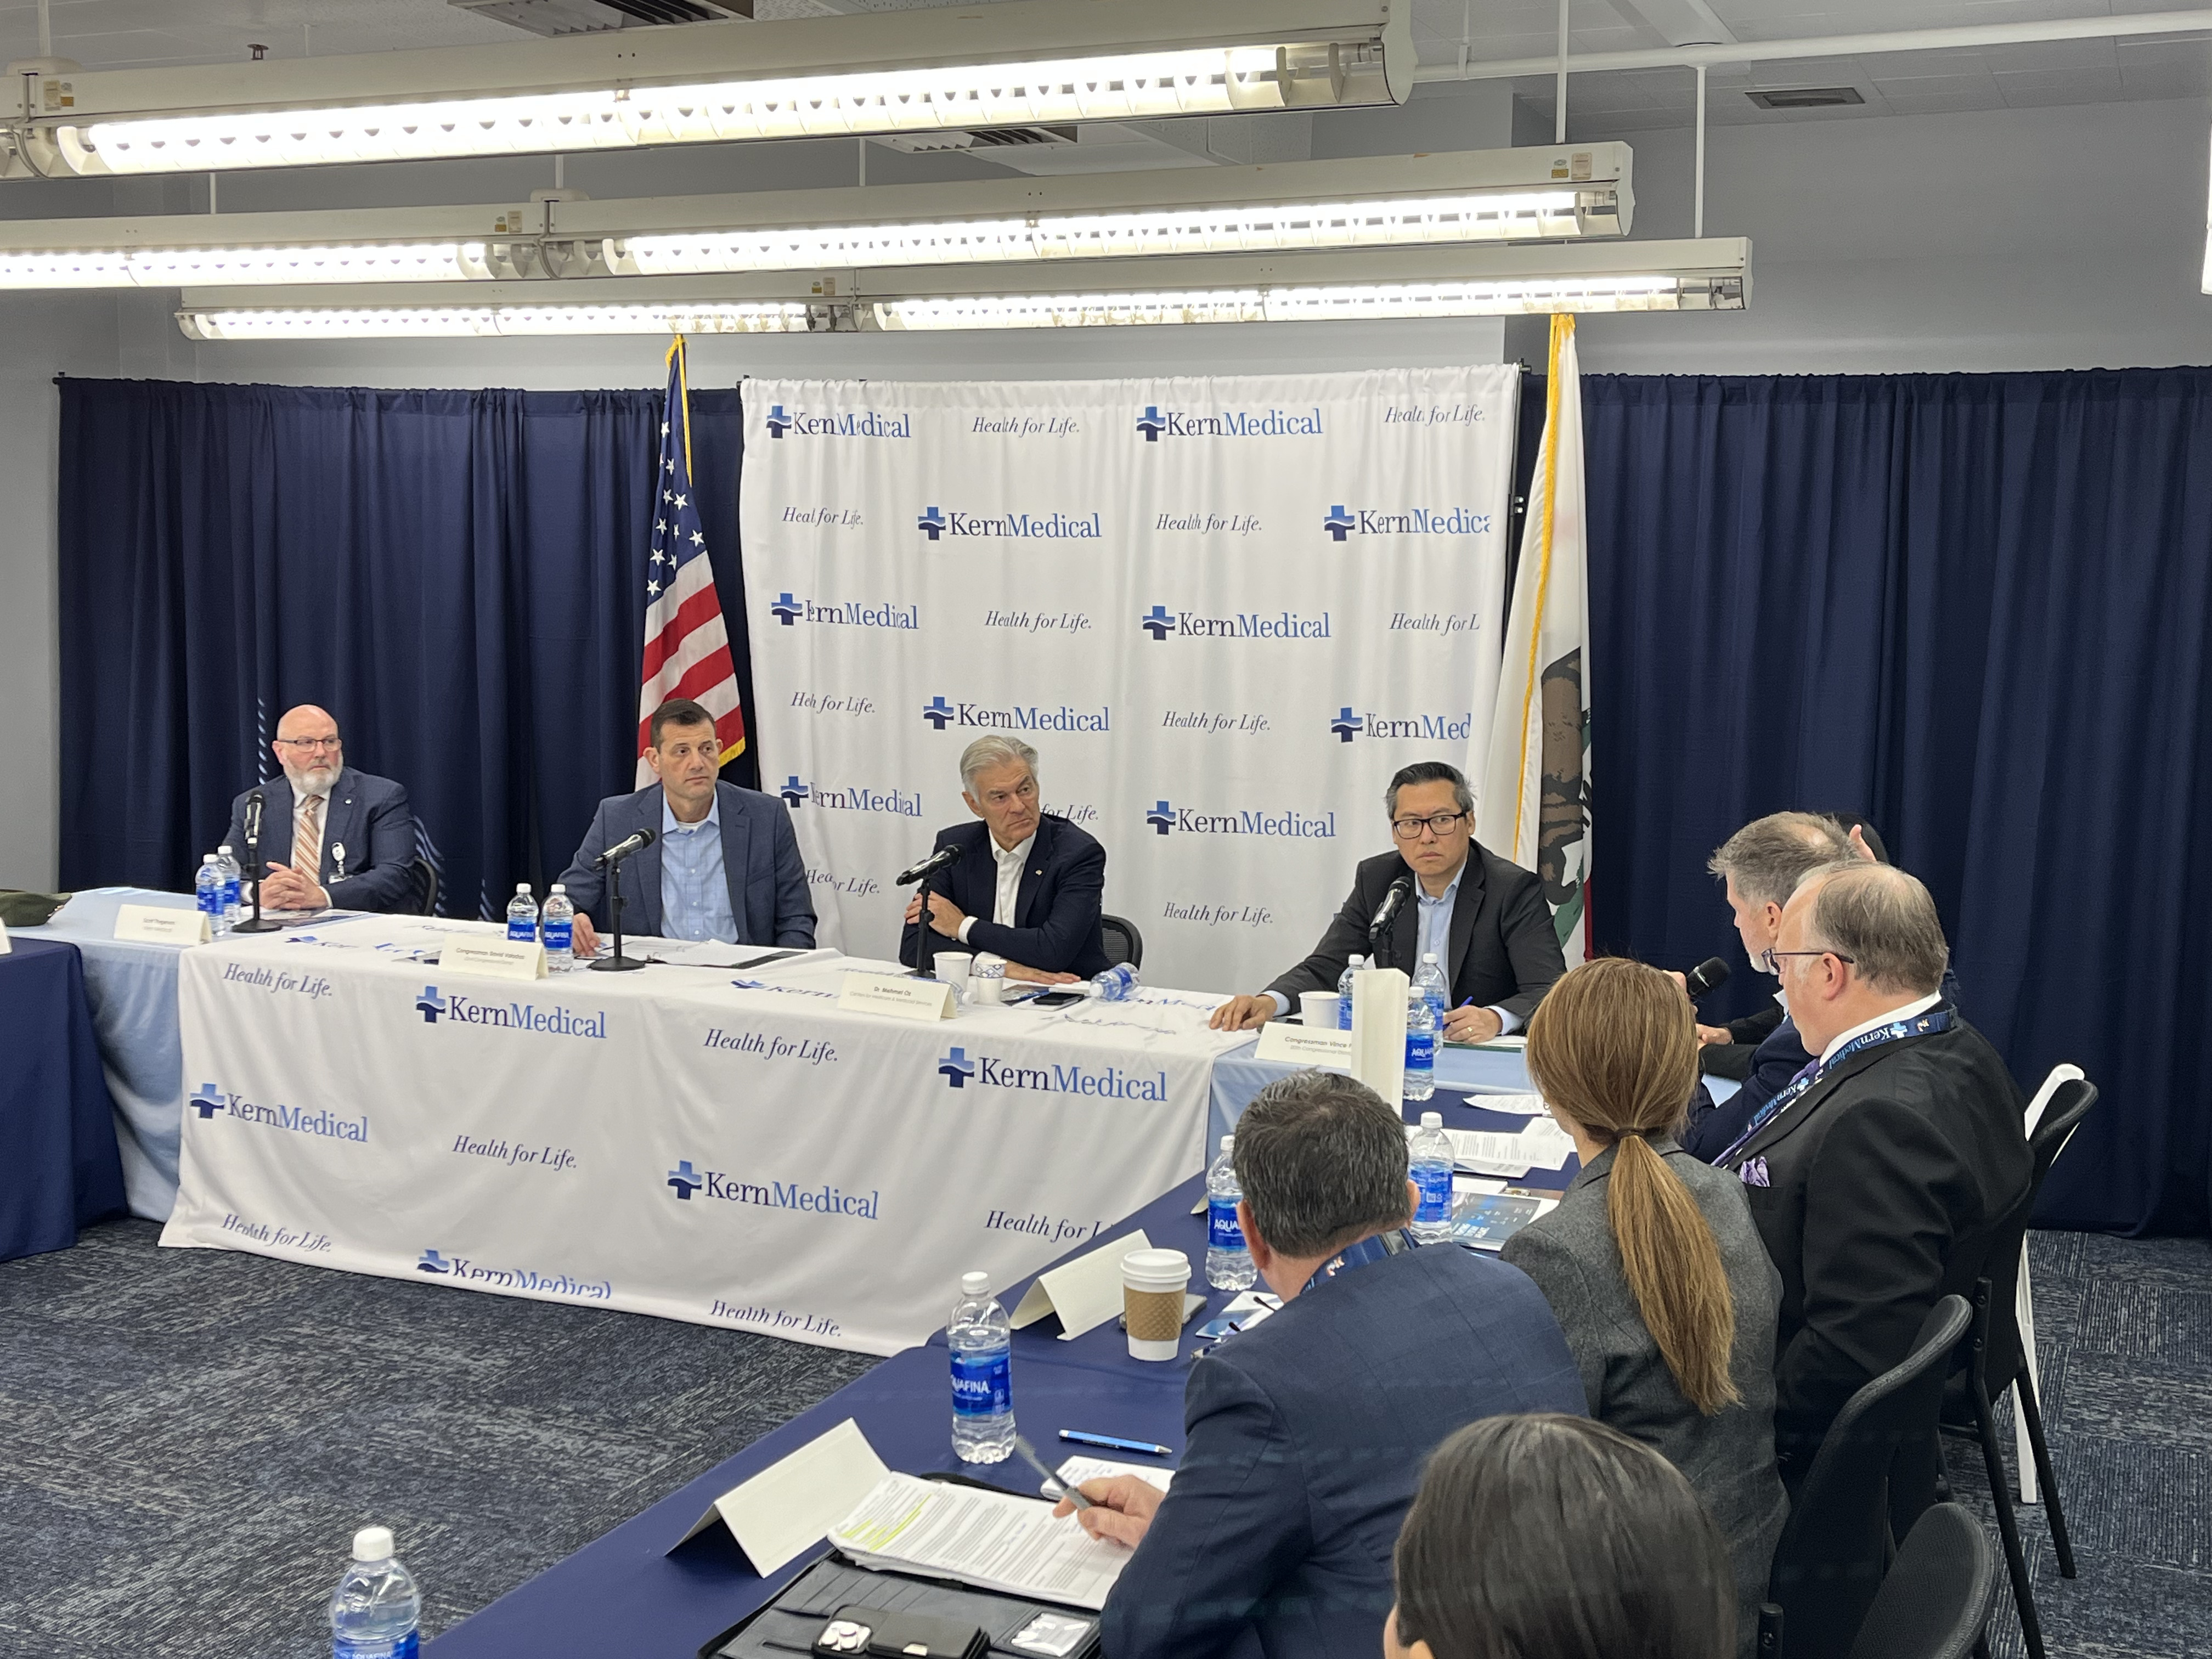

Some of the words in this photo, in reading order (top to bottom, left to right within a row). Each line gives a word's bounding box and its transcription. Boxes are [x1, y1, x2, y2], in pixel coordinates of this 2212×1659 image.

[971, 417, 1018, 433] Health
[1019, 417, 1045, 438] for
[1047, 416, 1080, 438] Life.
[1166, 408, 1324, 437] KernMedical
[1384, 405, 1424, 423] Healt
[1425, 405, 1451, 426] for
[1452, 404, 1485, 426] Life.
[782, 507, 815, 522] Heal
[815, 507, 839, 527] for
[949, 512, 1102, 538] KernMedical
[1155, 514, 1201, 531] Health
[1201, 513, 1228, 534] for
[1230, 515, 1262, 536] Life.
[1358, 507, 1491, 534] KernMedica
[985, 610, 1029, 629] Health
[1029, 612, 1058, 633] for
[1059, 612, 1092, 634] Life.
[1178, 612, 1331, 638] KernMedical
[1389, 613, 1440, 630] Health
[1440, 614, 1468, 637] for
[816, 695, 844, 714] for
[846, 696, 875, 716] Life.
[957, 703, 1110, 732] KernMedical
[1162, 710, 1208, 729] Health
[1208, 713, 1237, 734] for
[1239, 714, 1271, 735] Life.
[1066, 805, 1098, 825] Life.
[1177, 808, 1336, 838] KernMedical
[846, 878, 880, 898] Life.
[1163, 902, 1210, 921] Health
[1210, 905, 1239, 926] for
[1240, 906, 1273, 928] Life.
[224, 963, 272, 987] Health
[270, 972, 299, 994] for
[299, 975, 332, 1000] Life.
[449, 995, 607, 1039] KernMedical
[703, 1028, 764, 1054] Health
[764, 1036, 798, 1060] for
[798, 1039, 838, 1065] Life.
[978, 1057, 1168, 1102] KernMedical
[228, 1093, 368, 1143] KernMedical
[452, 1135, 508, 1160] Health
[507, 1143, 539, 1166] for
[540, 1147, 577, 1171] Life.
[704, 1171, 878, 1220] KernMedical
[984, 1210, 1050, 1237] Health
[1050, 1219, 1087, 1243] for
[266, 1227, 299, 1247] for
[296, 1232, 331, 1253] Life.
[709, 1299, 771, 1324] Health
[771, 1308, 803, 1329] for
[804, 1313, 842, 1338] Life.
